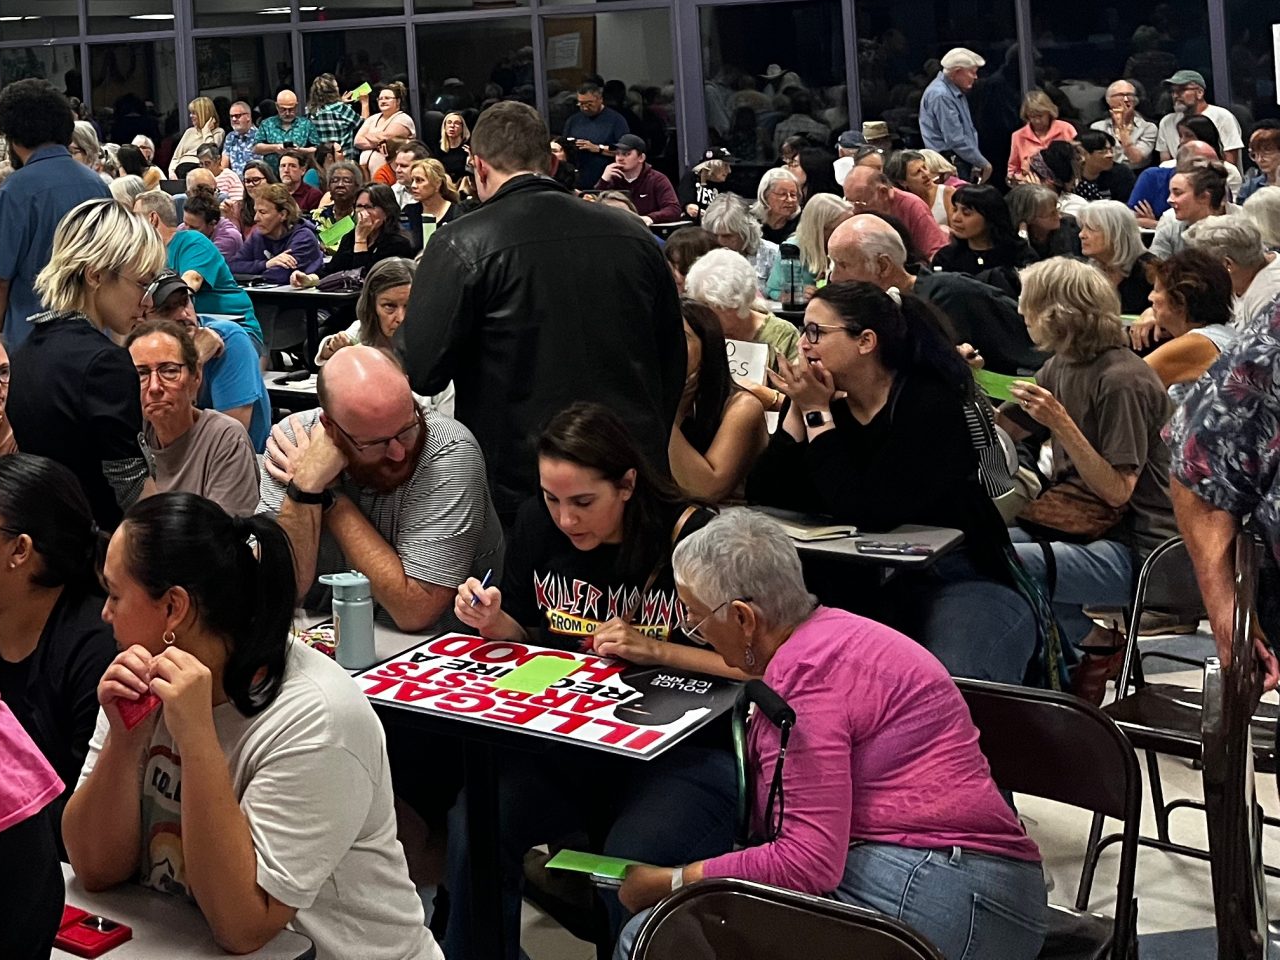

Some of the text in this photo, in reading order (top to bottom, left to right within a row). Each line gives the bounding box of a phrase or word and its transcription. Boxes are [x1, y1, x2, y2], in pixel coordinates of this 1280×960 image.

[533, 569, 603, 620] KILLER
[550, 613, 582, 632] FROM
[439, 658, 633, 701] REIRE
[650, 678, 708, 694] POLICE
[686, 679, 713, 689] ICE
[362, 675, 665, 750] ILLEGAL
